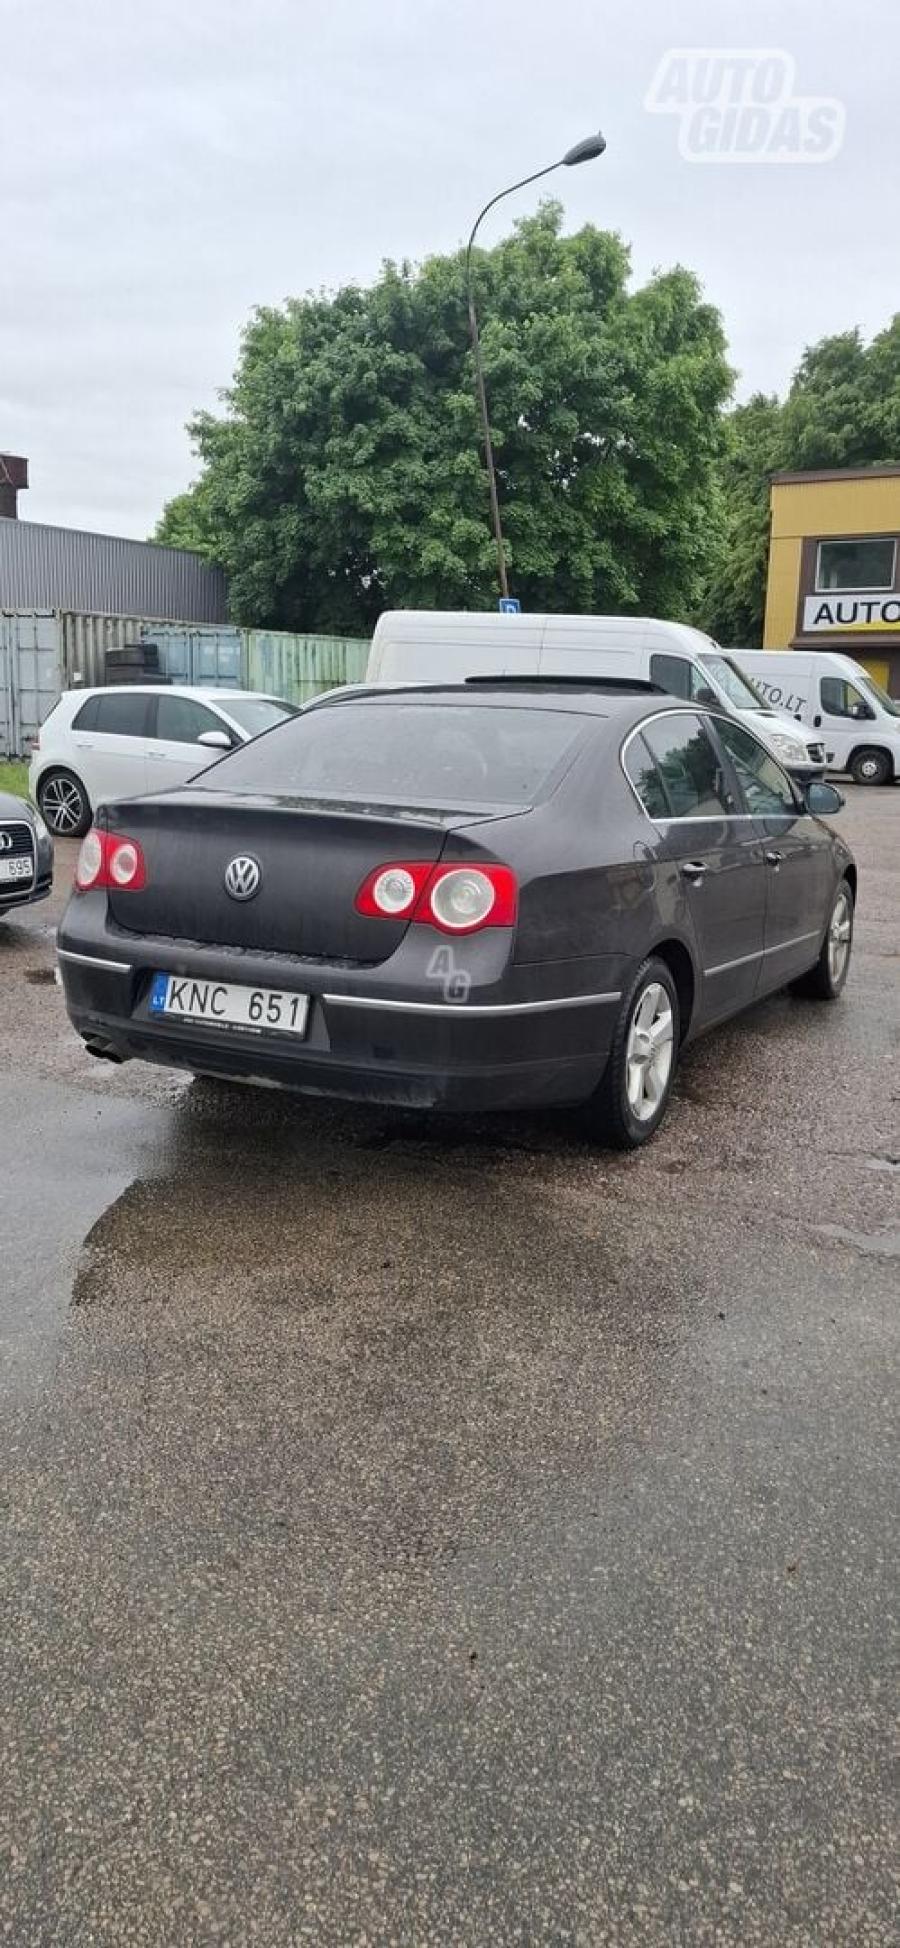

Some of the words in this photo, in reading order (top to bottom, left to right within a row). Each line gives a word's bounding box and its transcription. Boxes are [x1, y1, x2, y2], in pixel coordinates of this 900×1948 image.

[812, 600, 900, 625] AUTO
[168, 980, 228, 1016] KNC
[248, 991, 300, 1027] 651
